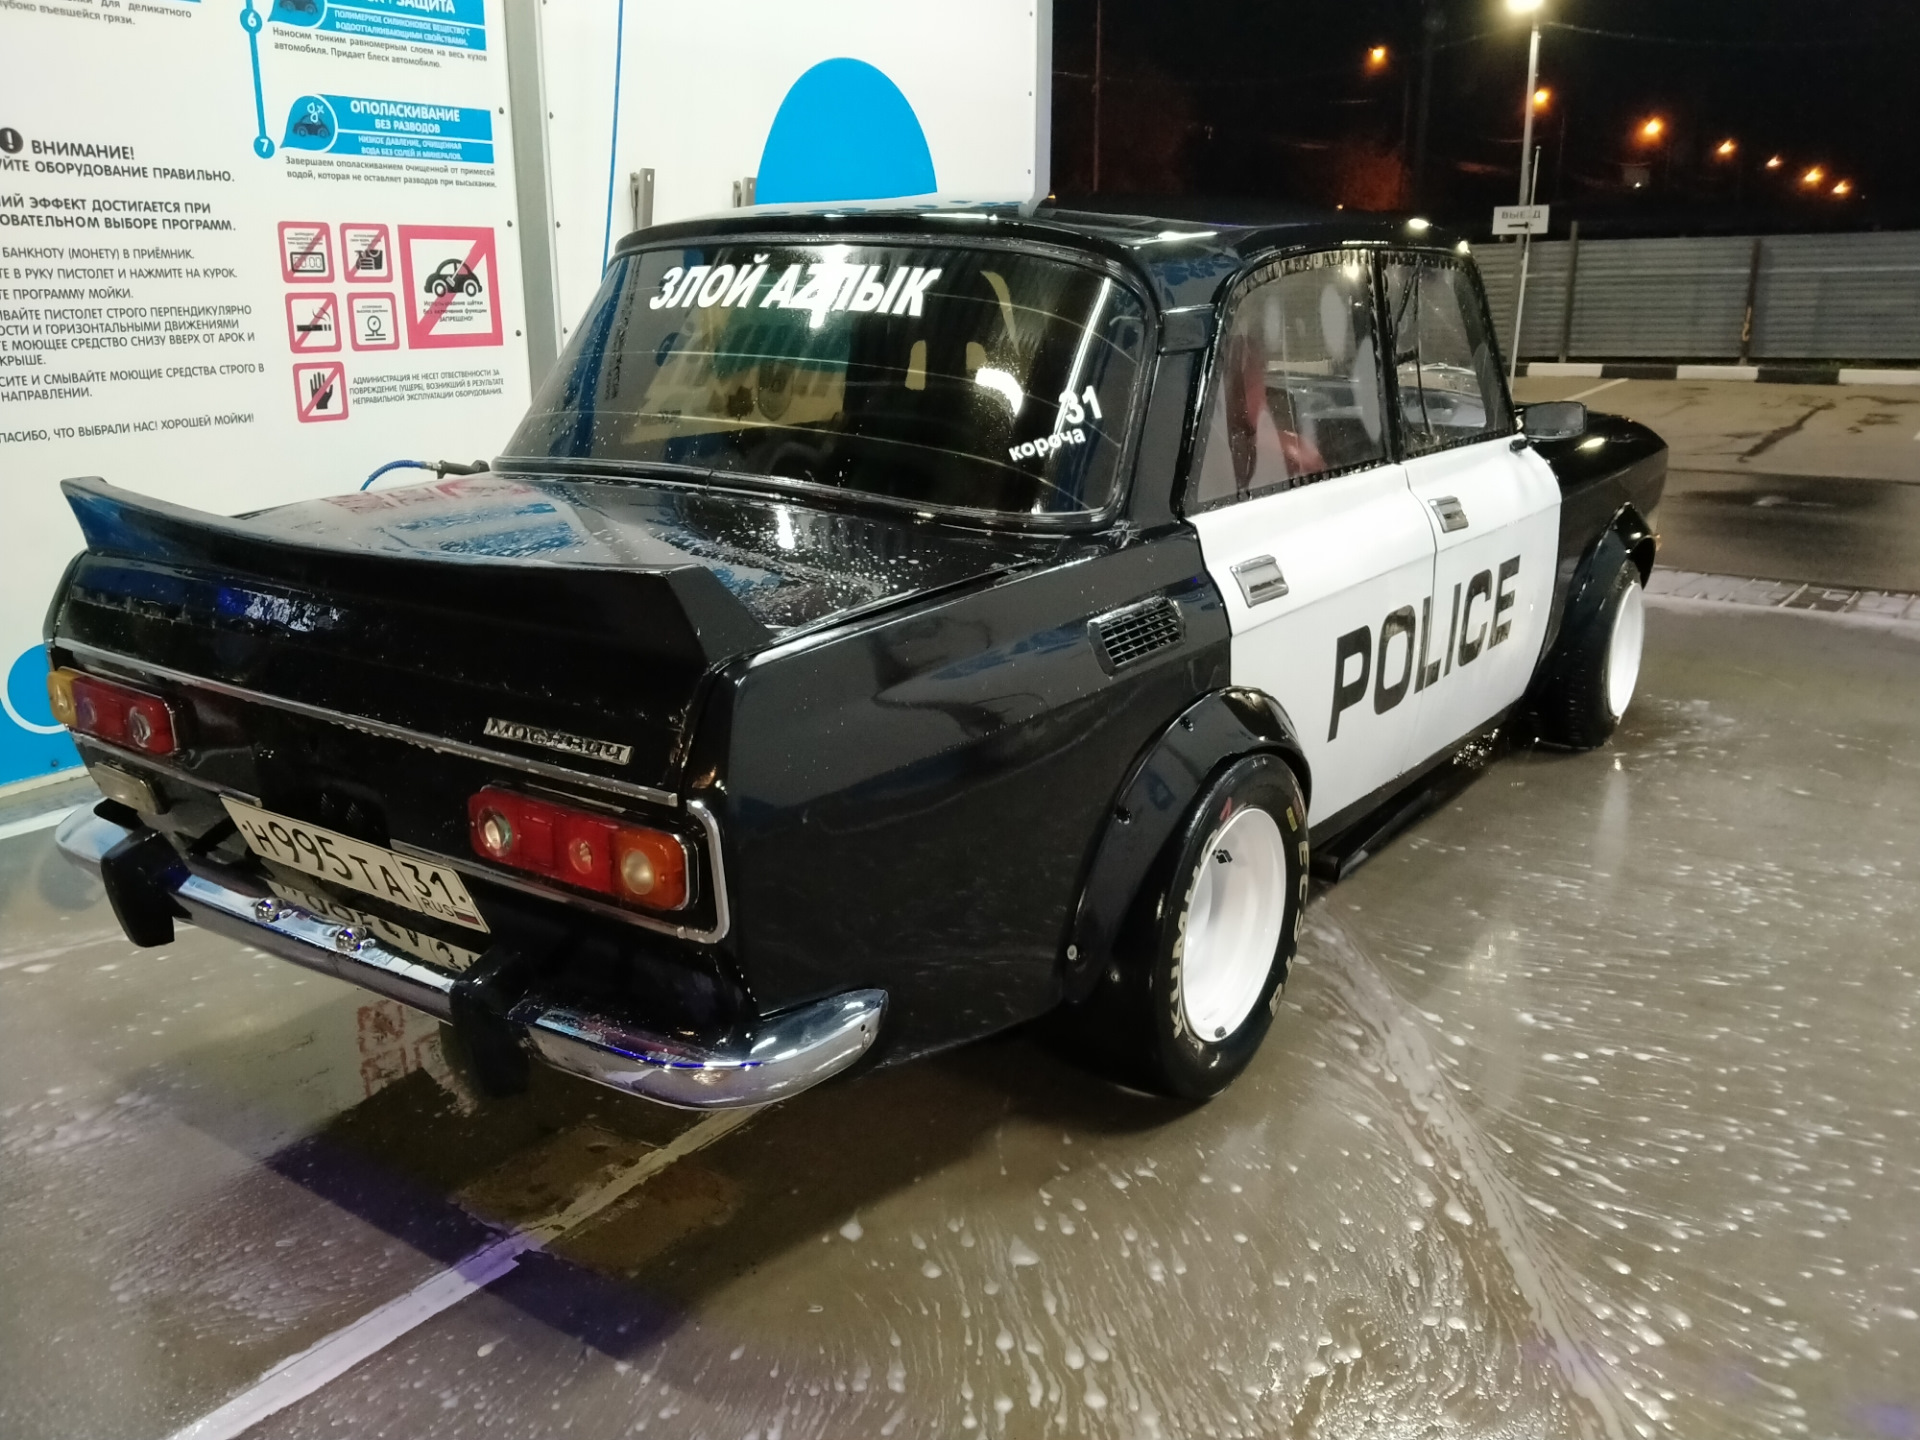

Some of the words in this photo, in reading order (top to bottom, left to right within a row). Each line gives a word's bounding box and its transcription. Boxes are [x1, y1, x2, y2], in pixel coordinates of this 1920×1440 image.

[40, 5, 101, 20] въевшейся
[103, 13, 136, 25] грязи.
[128, 2, 192, 18] деликатного
[247, 15, 257, 28] 6
[272, 27, 312, 39] Наносим
[315, 34, 347, 44] тонким
[349, 38, 408, 52] равномерным
[410, 45, 434, 55] слоем
[448, 50, 465, 59] весь
[467, 53, 488, 62] кузов
[274, 41, 329, 55] автомобиля.
[330, 47, 365, 60] Придает
[367, 51, 390, 62] блеск
[391, 56, 442, 68] автомобилю.
[350, 100, 460, 122] ОПОЛАСКИВАНИЕ
[375, 119, 391, 130] БЕЗ
[393, 120, 440, 135] РАЗВОДОВ
[31, 139, 135, 160] ВНИМАНИЕ!
[260, 138, 269, 153] 7
[0, 155, 30, 172] ЙТЕ
[35, 161, 149, 178] ОБОРУДОВАНИЕ
[153, 167, 235, 182] ПРАВИЛЬНО.
[285, 155, 334, 168] Завершаем
[336, 160, 403, 171] ополаскиванием
[405, 164, 448, 174] очищенной
[460, 167, 495, 176] примесей
[287, 170, 316, 180] водой,
[317, 172, 350, 181] которая
[363, 174, 401, 183] оставляет
[404, 177, 438, 186] разводов
[440, 179, 453, 187] при
[29, 196, 86, 210] ЭФФЕКТ
[92, 199, 180, 213] ДОСТИГАЕТСЯ
[184, 202, 211, 214] ПРИ
[1501, 210, 1541, 219] ВЫЕД
[104, 217, 158, 230] ВЫБОРЕ
[162, 218, 236, 231] ПРОГРАММ.
[2, 247, 64, 259] БАНКНОТУ
[68, 248, 119, 260] (МОНЕТУ)
[123, 249, 130, 259] В
[133, 246, 195, 259] ПРИЁМНИК.
[13, 268, 21, 279] В
[25, 268, 53, 280] РУКУ
[57, 268, 114, 279] ПИСТОЛЕТ
[118, 269, 126, 279] И
[130, 268, 182, 279] НАЖМИТЕ
[186, 268, 200, 278] НА
[203, 268, 237, 279] КУРОК.
[649, 253, 770, 309] ЗЛОЙ
[13, 289, 85, 300] ПРОГРАММУ
[88, 286, 133, 299] МОЙКИ.
[0, 307, 41, 321] ВАЙТЕ
[44, 308, 103, 320] ПИСТОЛЕТ
[106, 307, 147, 319] СТРОГО
[150, 304, 252, 318] ПЕРПЕНДИКУЛЯРНО
[33, 324, 42, 335] И
[45, 322, 161, 336] ГОРИЗОНТАЛЬНЫМИ
[164, 319, 239, 332] ДВИЖЕНИЯМИ
[11, 339, 68, 351] МОЮЩЕЕ
[71, 337, 128, 350] СРЕДСТВО
[131, 335, 166, 347] СНИЗУ
[169, 334, 200, 346] ВВЕРХ
[203, 333, 215, 344] ОТ
[218, 332, 245, 343] АРОК
[247, 331, 255, 342] И
[31, 374, 41, 385] И
[44, 370, 107, 385] СМЫВАЙТЕ
[110, 368, 163, 381] МОЮЩИЕ
[166, 365, 217, 378] СРЕДСТВА
[219, 363, 256, 375] СТРОГО
[258, 363, 265, 373] В
[353, 374, 410, 384] АДМИНИСТРАЦИЯ
[412, 373, 420, 381] НЕ
[421, 372, 439, 381] НЕСЕТ
[1, 387, 92, 402] НАПРАВЛЕНИИ.
[349, 385, 397, 395] ПОВРЕЖДЕНИЕ
[425, 379, 466, 390] ВОЗНИКШИЙ
[472, 378, 504, 386] РЕЗУЛЬТАТЕ
[352, 393, 405, 405] НЕПРАВИЛЬНОЙ
[406, 390, 453, 400] ЭКСПЛУАТАЦИИ
[1058, 385, 1102, 424] 31
[53, 427, 75, 439] ЧТО
[78, 423, 131, 437] ВЫБРАЛИ
[133, 420, 158, 432] НАС!
[160, 413, 211, 429] ХОРОШЕЙ
[214, 412, 255, 426] МОЙКИ!
[1008, 428, 1086, 462] короча
[1327, 555, 1521, 743] POLICE
[422, 897, 457, 918] RUS
